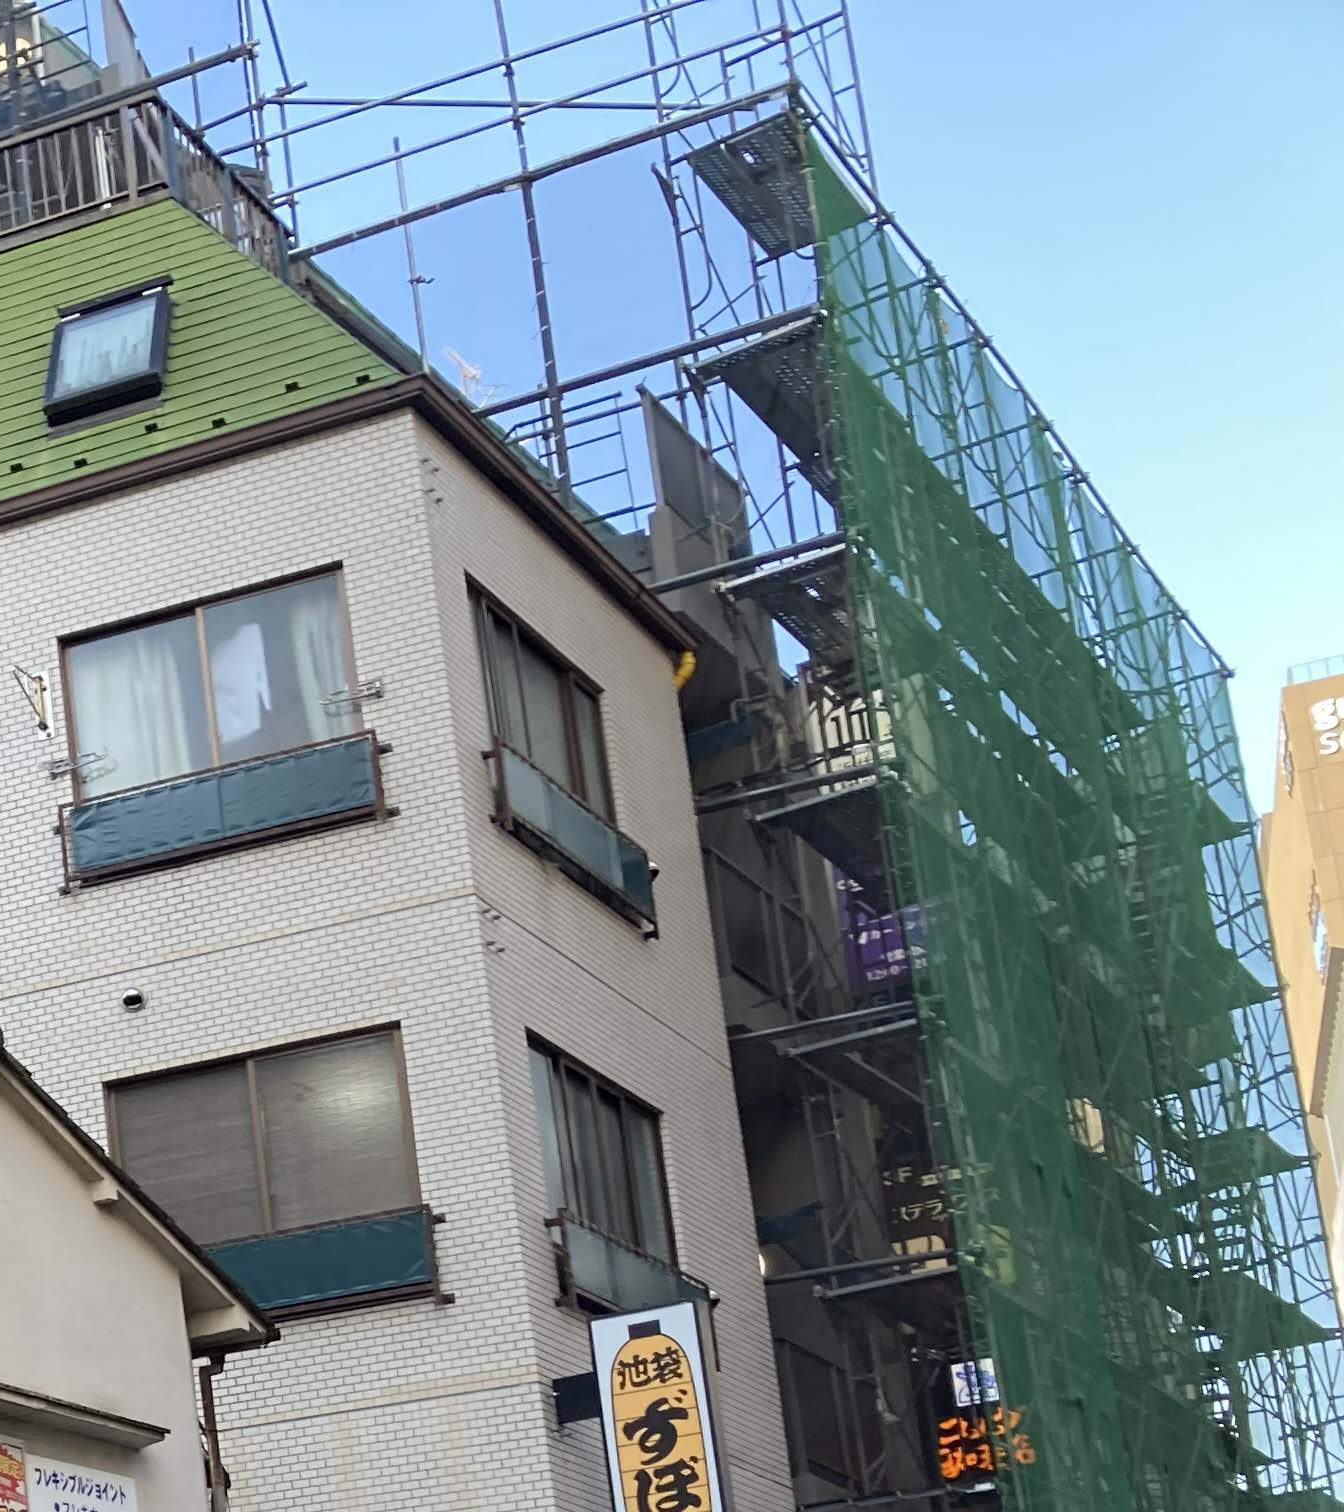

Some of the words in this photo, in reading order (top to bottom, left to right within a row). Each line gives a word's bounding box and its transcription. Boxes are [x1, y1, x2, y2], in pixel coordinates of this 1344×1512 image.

[616, 1346, 684, 1390] 池袋
[34, 1467, 127, 1505] フレキシブルジョイント
